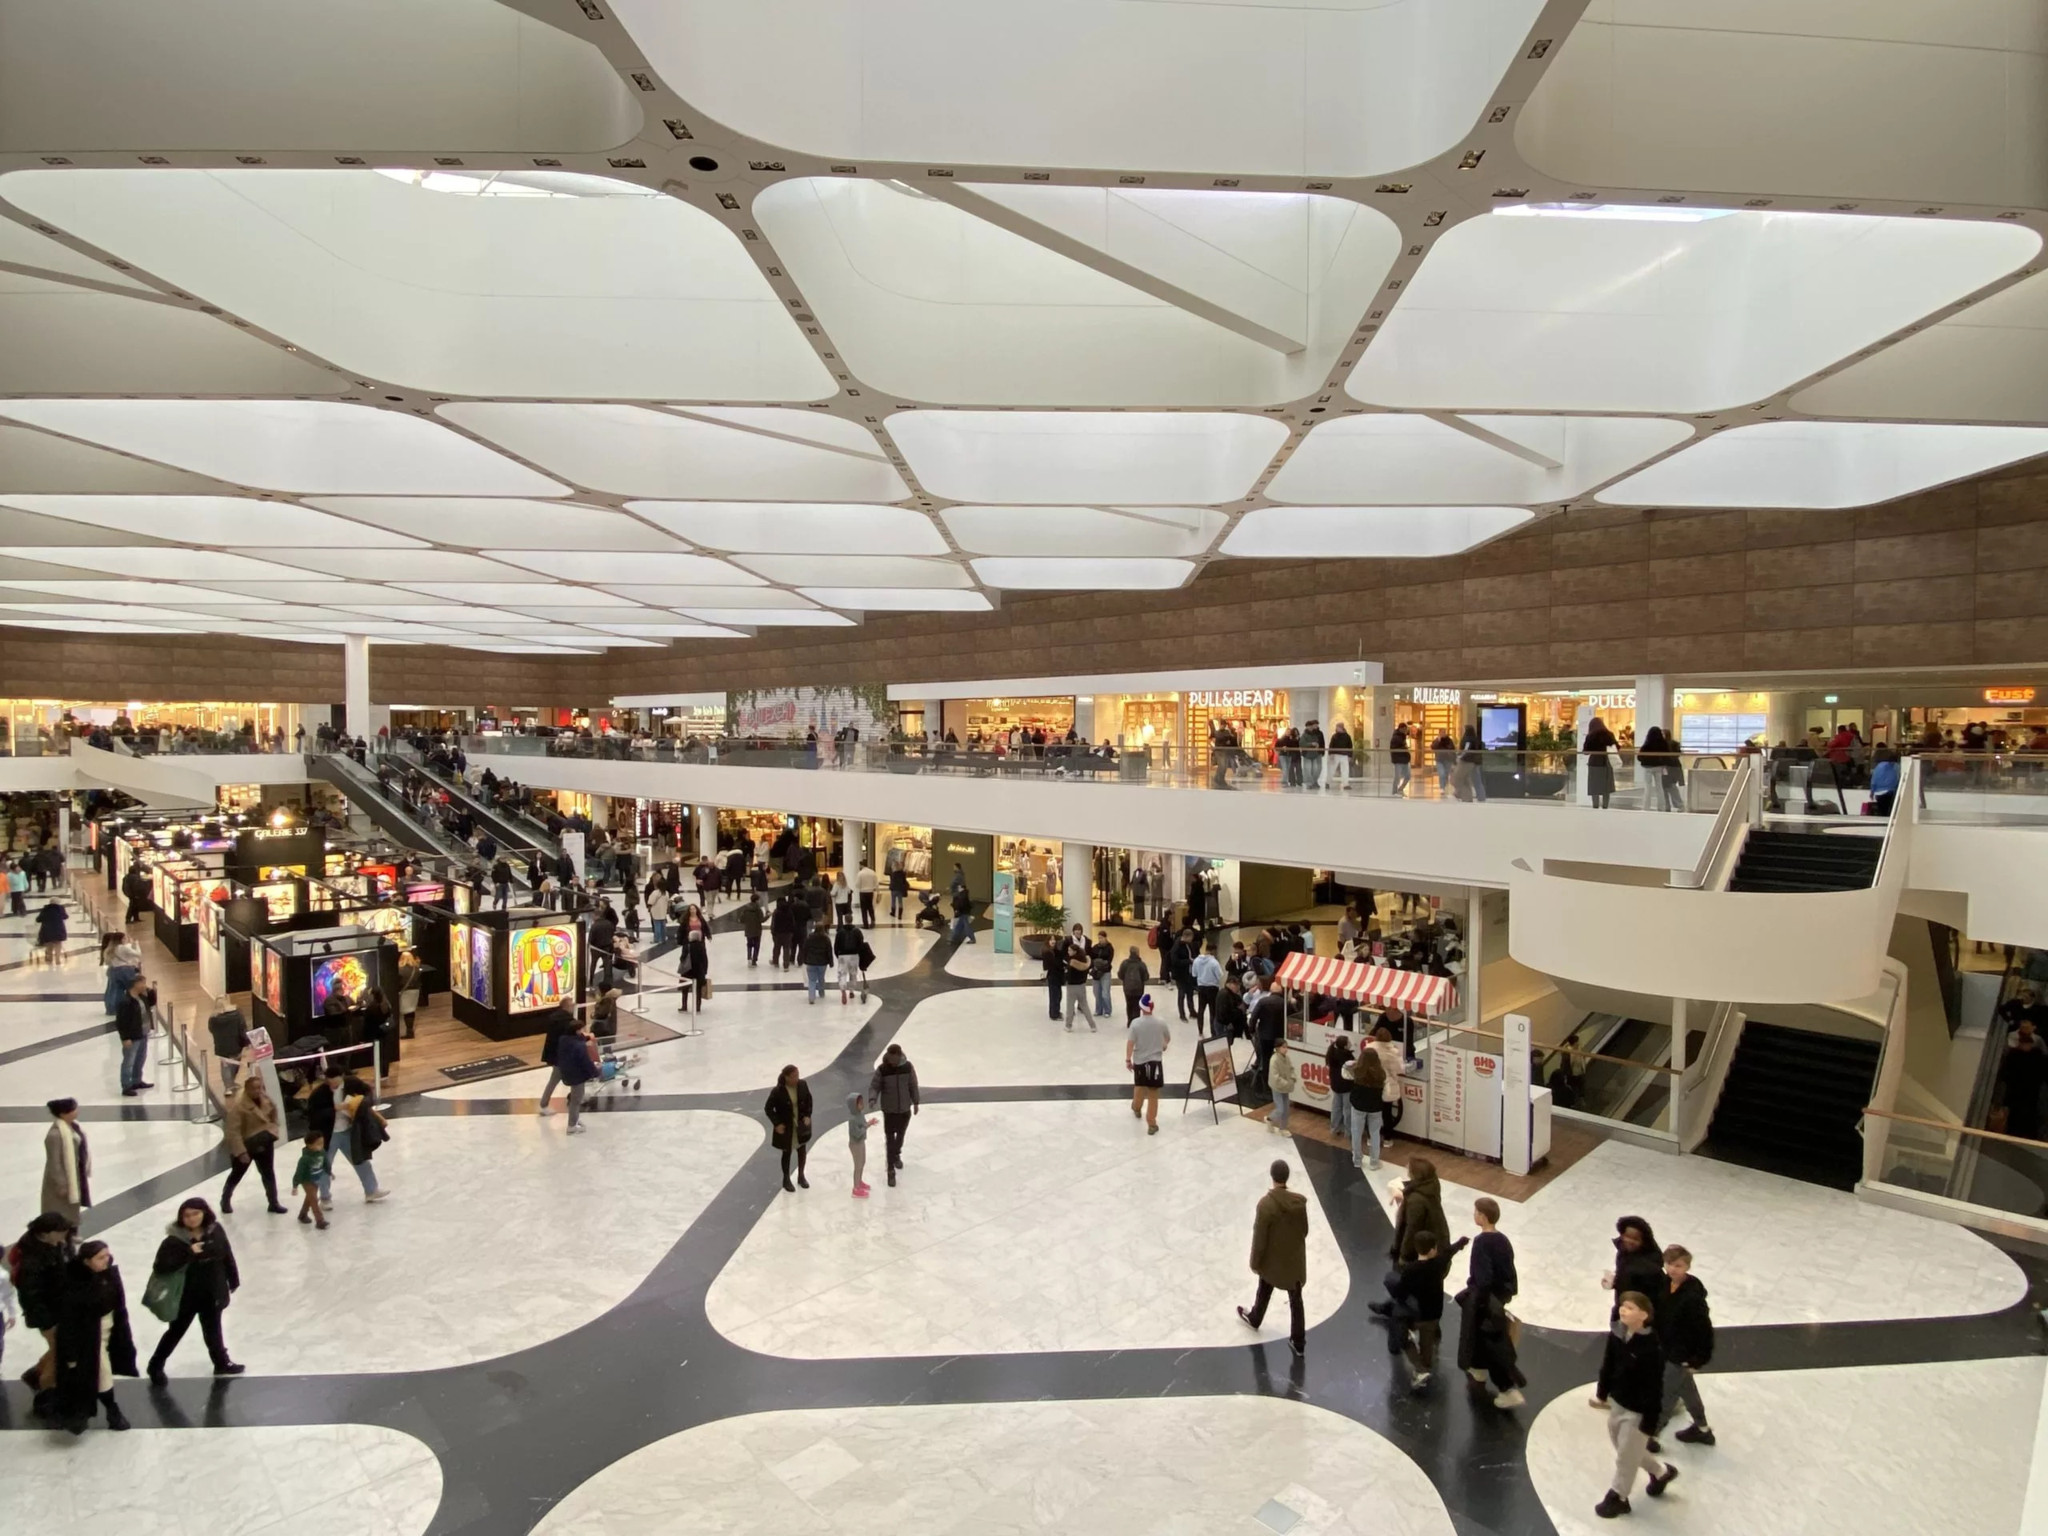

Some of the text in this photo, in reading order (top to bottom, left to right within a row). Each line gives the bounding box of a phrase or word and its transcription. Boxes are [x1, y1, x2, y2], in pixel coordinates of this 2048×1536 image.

[1189, 689, 1274, 707] PULL&BEAR
[1413, 687, 1460, 705] PULL&BEAR
[254, 827, 308, 840] GALERIE 337
